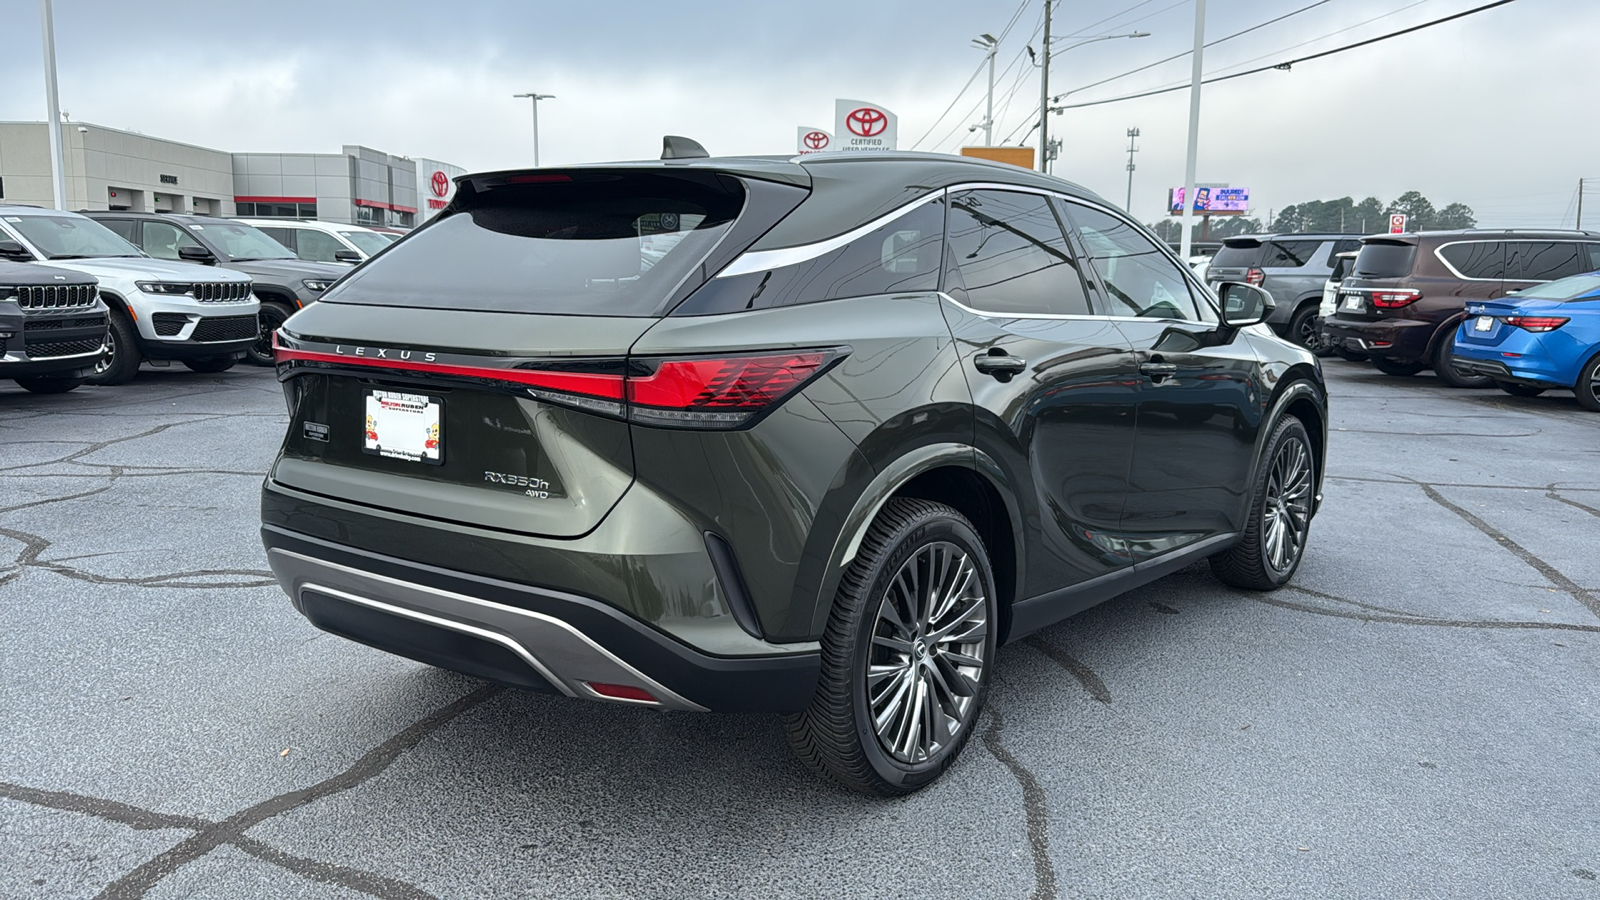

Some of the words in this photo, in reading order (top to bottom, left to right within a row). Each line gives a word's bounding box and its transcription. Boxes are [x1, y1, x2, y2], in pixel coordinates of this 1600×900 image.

[851, 138, 882, 146] CERTIFIED
[428, 198, 449, 209] TOYO
[335, 345, 437, 362] LEXUS
[525, 489, 549, 499] AWD
